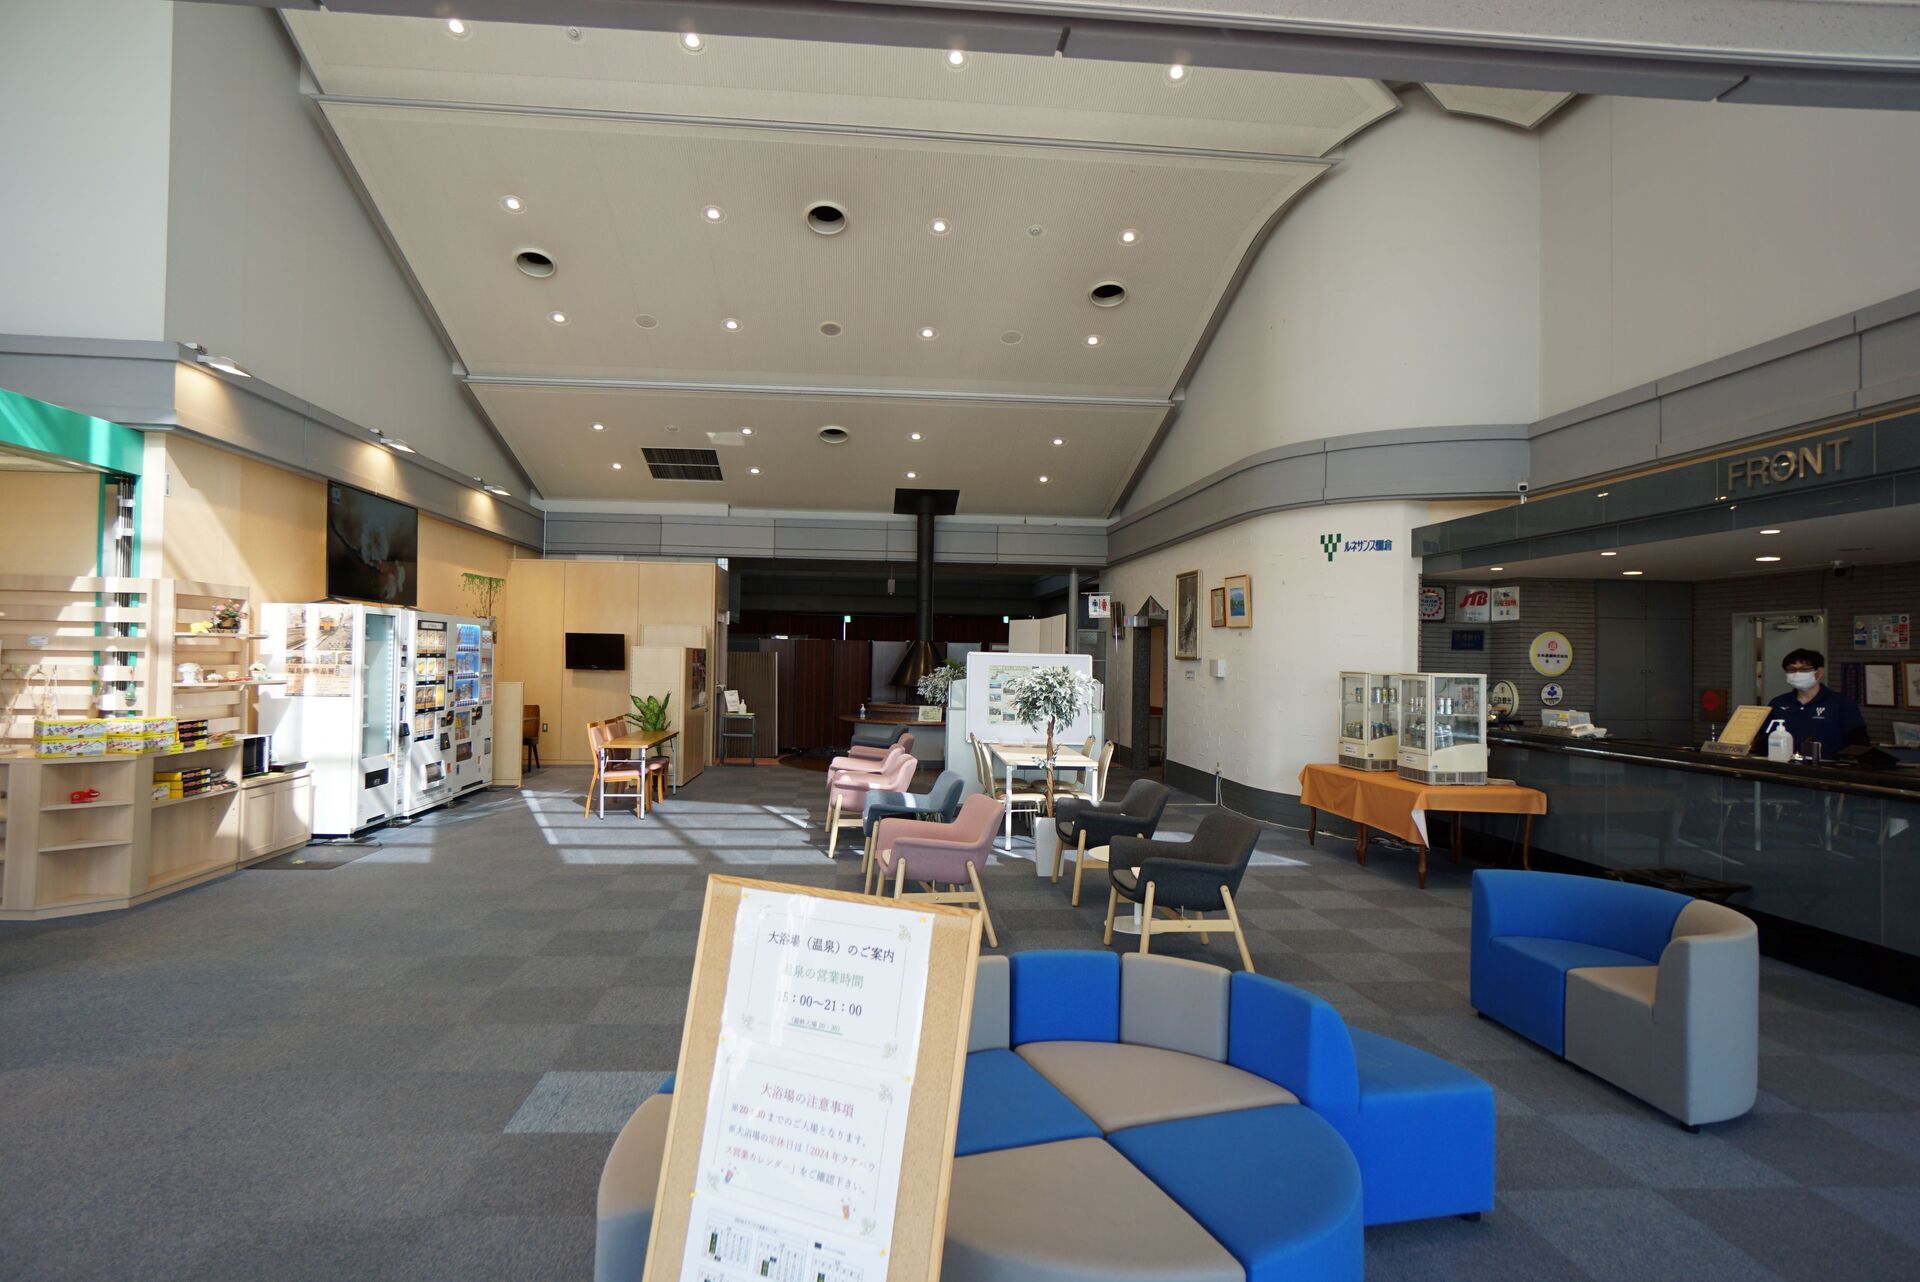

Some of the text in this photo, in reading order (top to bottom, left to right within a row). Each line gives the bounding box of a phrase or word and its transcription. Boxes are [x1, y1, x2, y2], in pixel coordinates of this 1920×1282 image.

[1728, 438, 1849, 491] FRONT
[1459, 590, 1488, 609] JTB
[760, 1082, 855, 1118] 大浴場の注意事項
